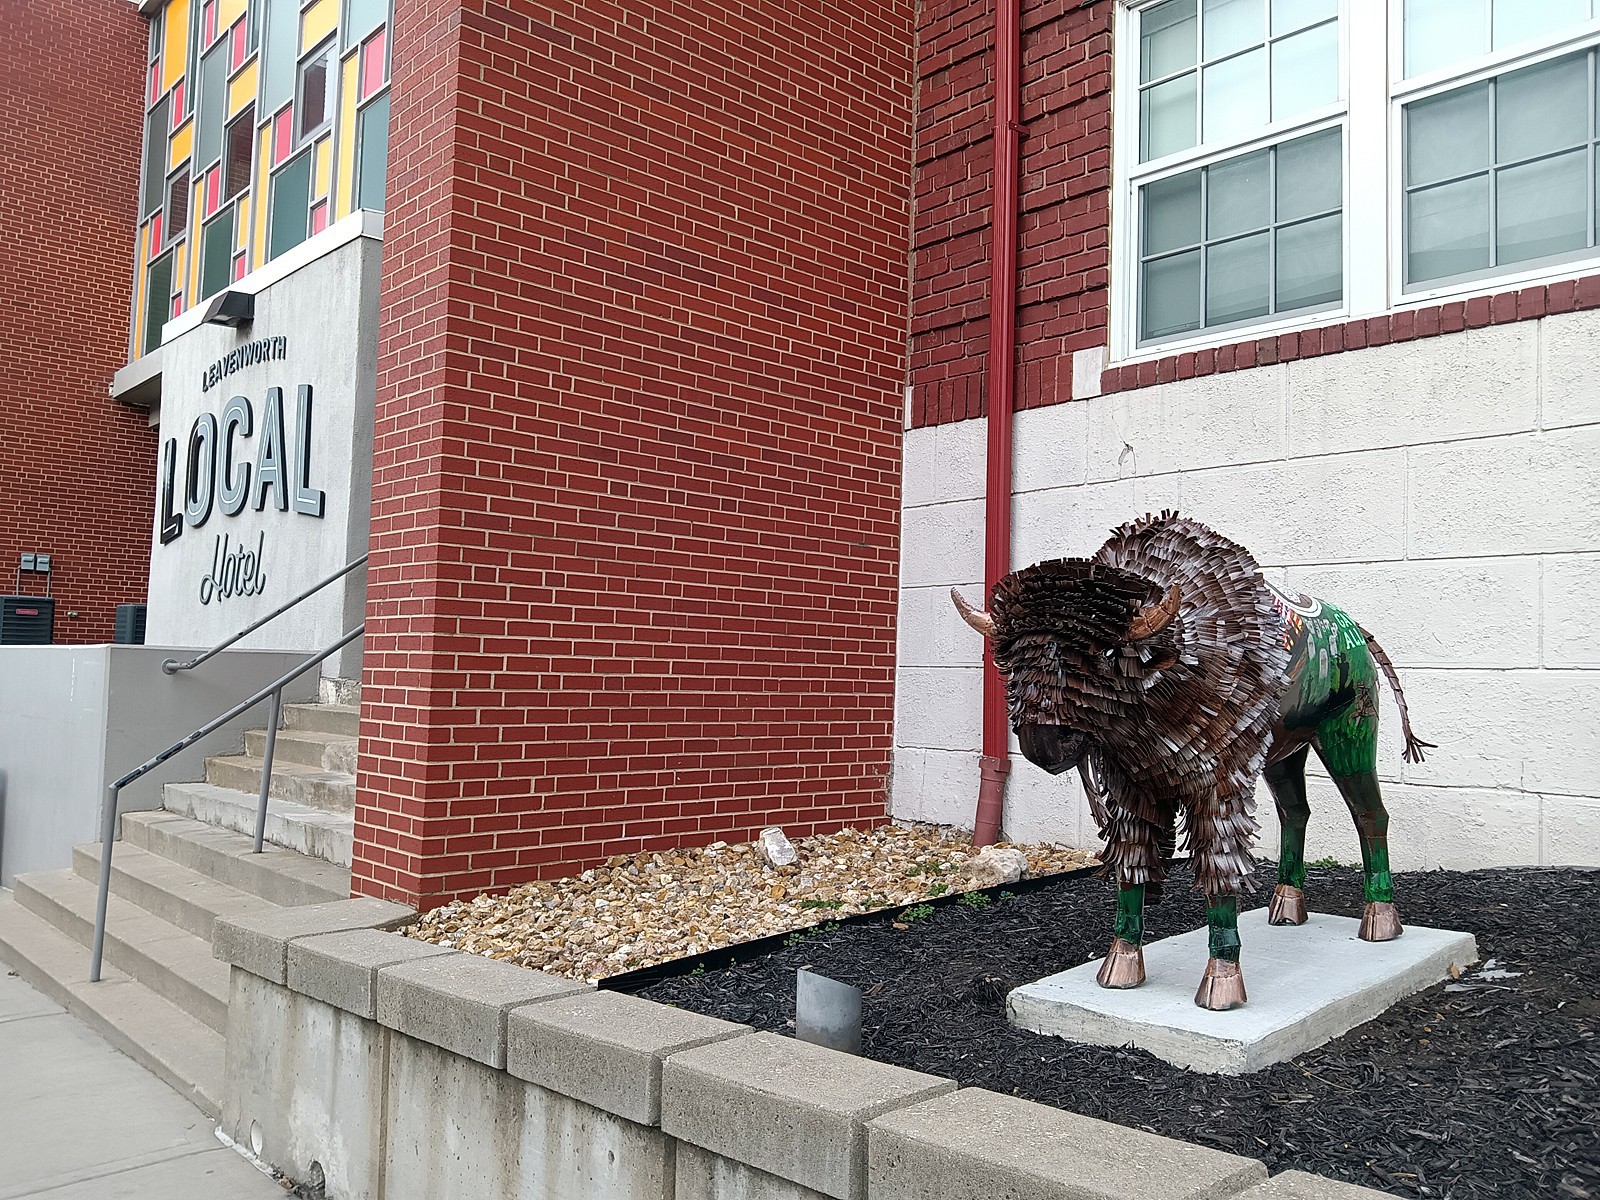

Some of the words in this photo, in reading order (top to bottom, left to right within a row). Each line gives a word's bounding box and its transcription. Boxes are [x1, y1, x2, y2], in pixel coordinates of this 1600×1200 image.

[202, 336, 287, 393] LEAVENWORTH
[160, 384, 325, 545] LOCAL
[199, 530, 266, 605] Hotel
